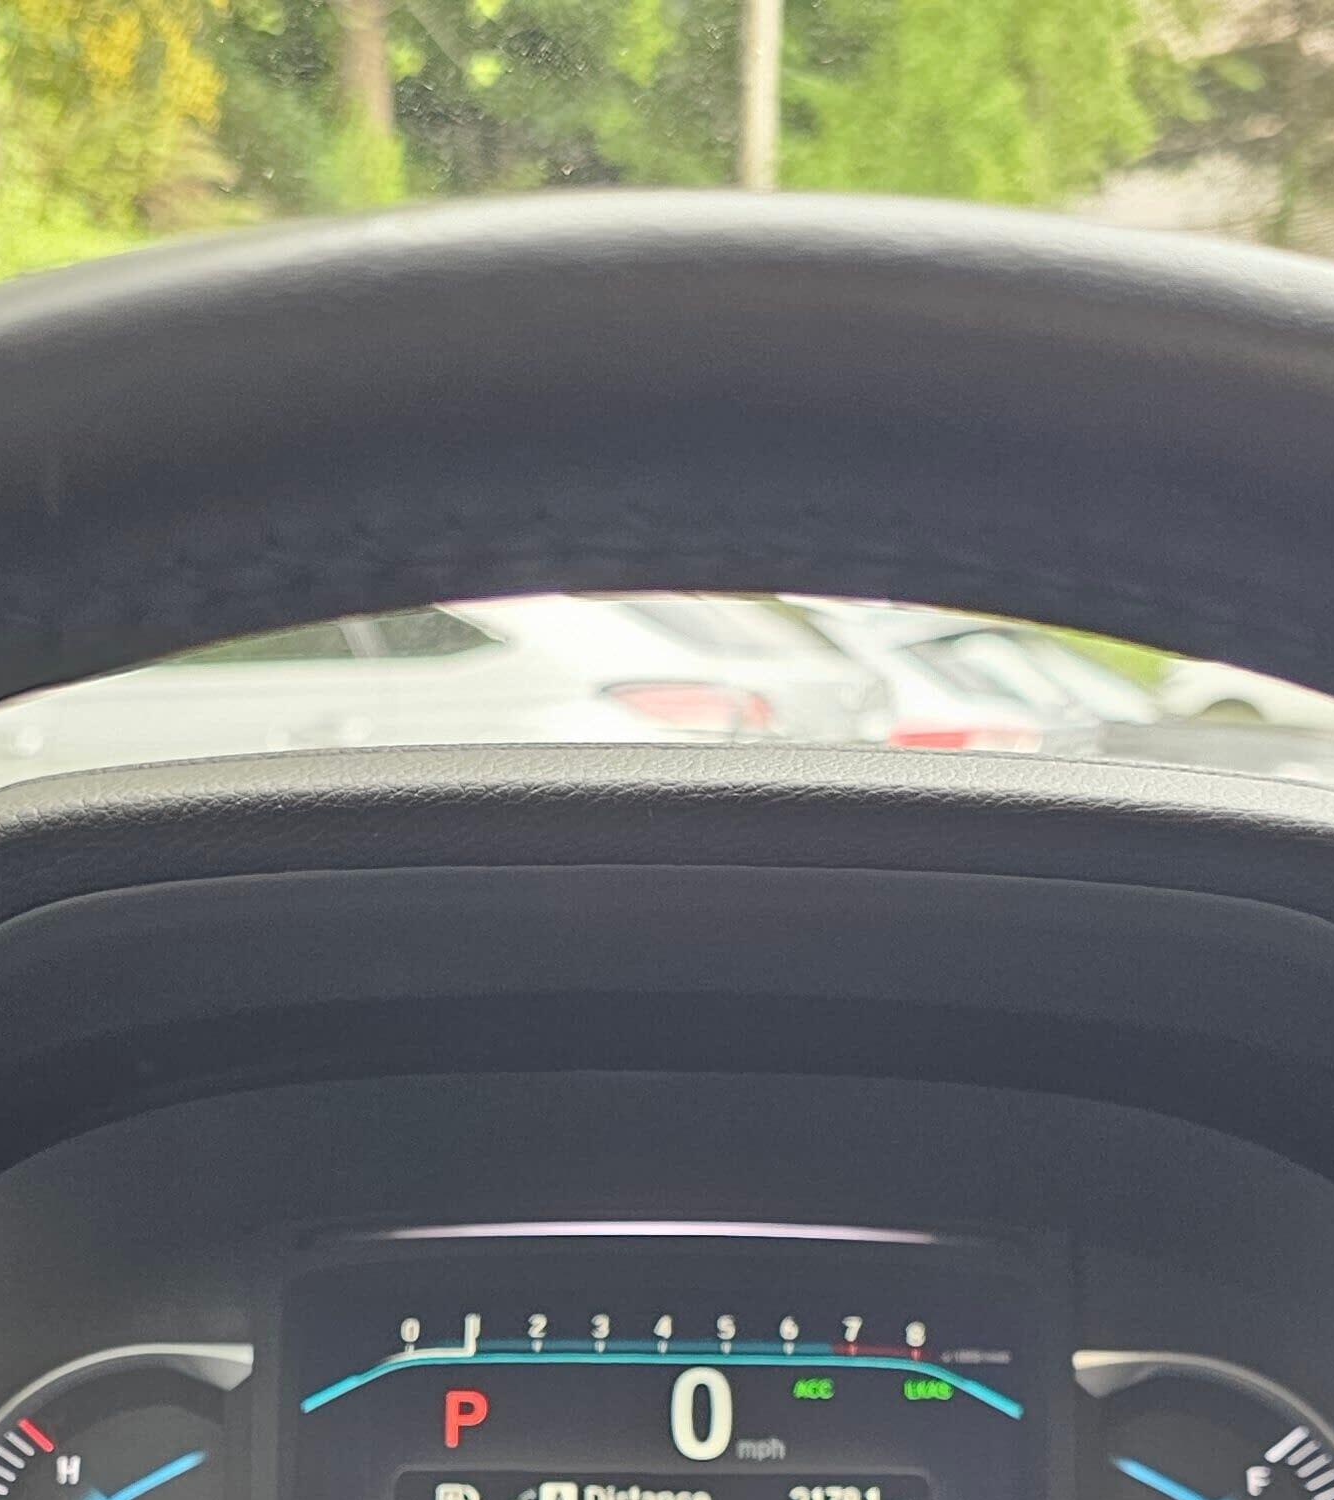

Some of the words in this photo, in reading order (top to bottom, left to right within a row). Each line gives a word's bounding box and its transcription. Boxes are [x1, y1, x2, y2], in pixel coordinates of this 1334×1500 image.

[401, 1317, 420, 1342] 0
[528, 1313, 548, 1339] 2
[591, 1313, 610, 1339] 3
[653, 1314, 673, 1339] 4
[717, 1314, 736, 1340] 5
[779, 1315, 799, 1340] 6
[842, 1316, 863, 1342] 7
[906, 1321, 926, 1347] 8
[444, 1389, 488, 1449] P
[670, 1366, 734, 1461] 0
[736, 1437, 785, 1464] mph
[56, 1455, 81, 1485] H
[1246, 1465, 1271, 1496] F
